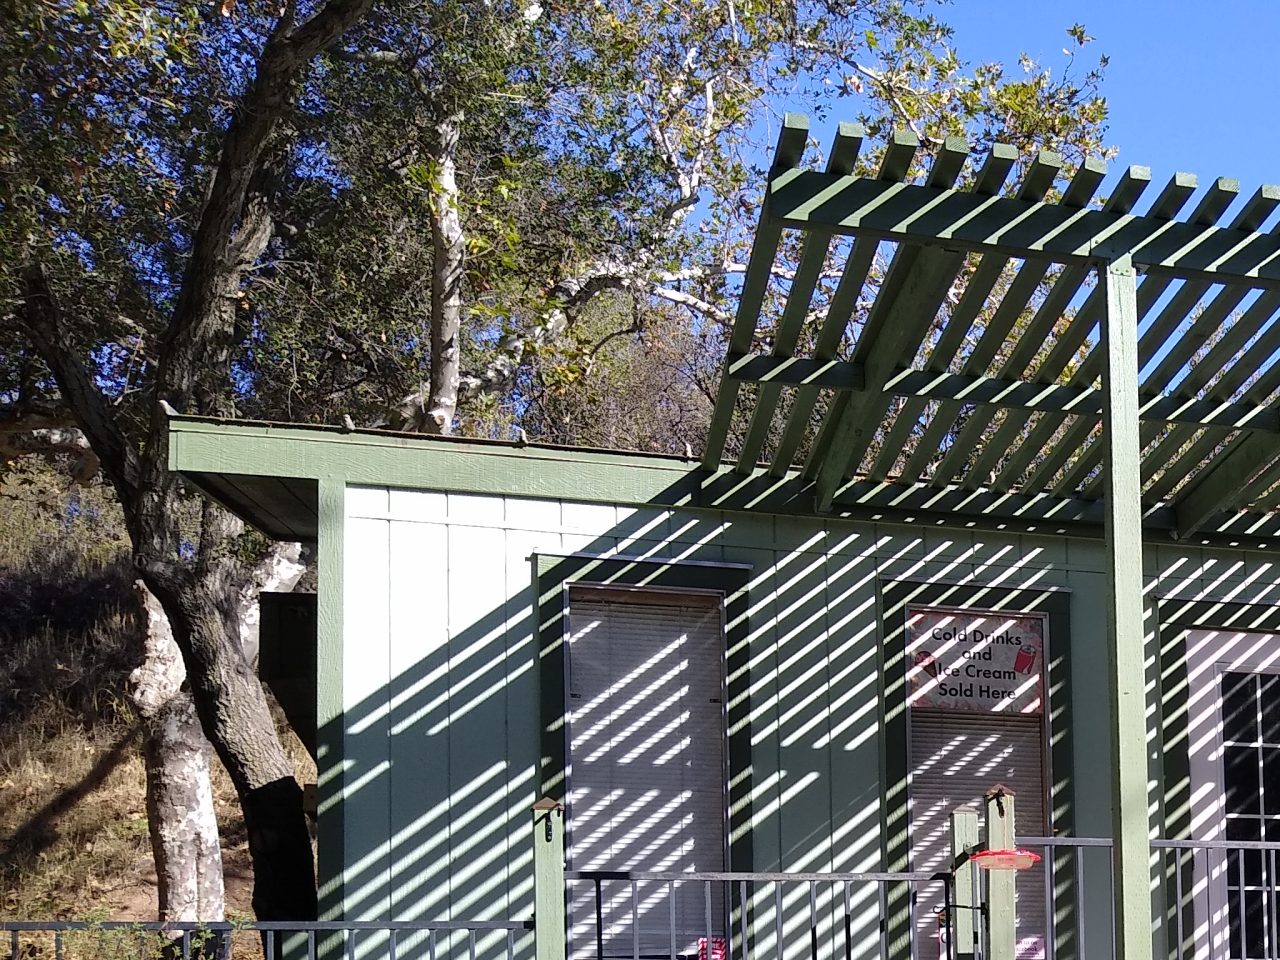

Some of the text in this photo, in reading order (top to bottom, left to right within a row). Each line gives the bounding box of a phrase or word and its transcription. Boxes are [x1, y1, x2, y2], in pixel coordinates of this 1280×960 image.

[932, 627, 1022, 646] Cold Drinks
[962, 646, 992, 661] and
[938, 662, 1016, 680] Ice Cream
[938, 682, 1016, 700] Sold Here
